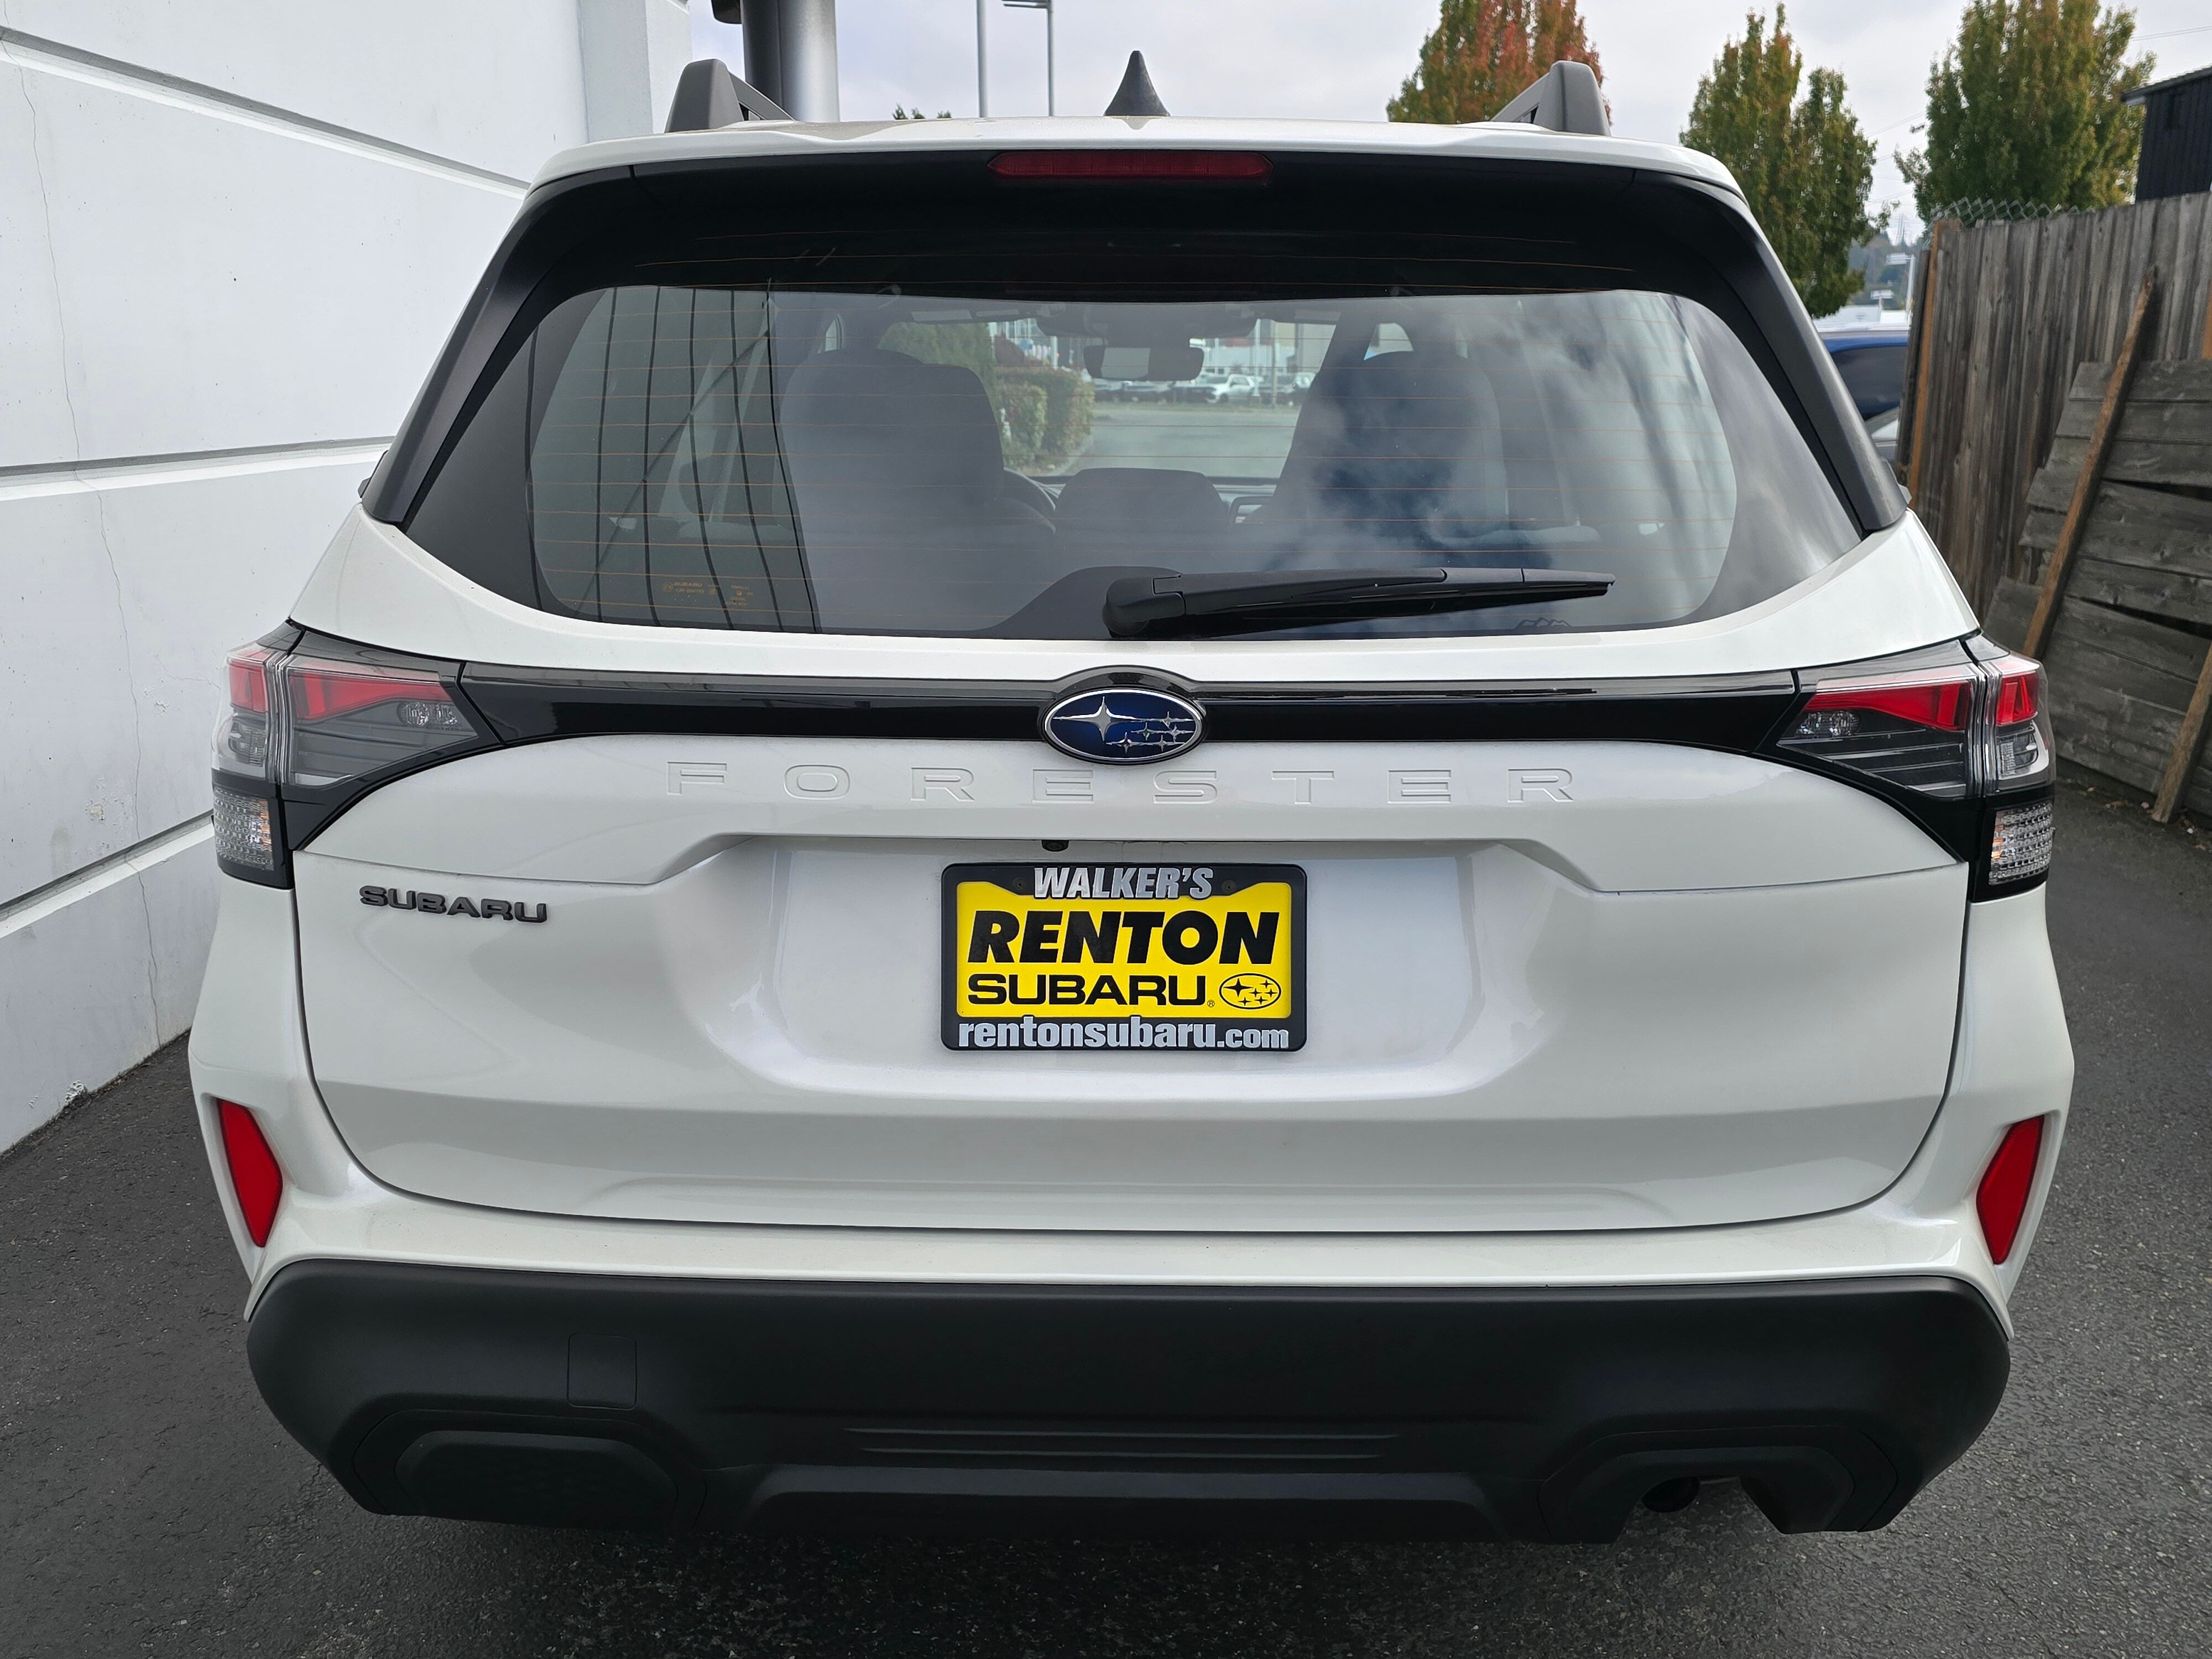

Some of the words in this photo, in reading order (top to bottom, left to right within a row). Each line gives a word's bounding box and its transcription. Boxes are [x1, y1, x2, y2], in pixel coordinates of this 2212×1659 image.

[667, 761, 1574, 805] FORESTER
[1034, 867, 1213, 899] WALKER'S
[359, 885, 547, 923] SUBARU
[968, 910, 1280, 964] RENTON
[959, 1016, 1289, 1048] rentonsubaru.com
